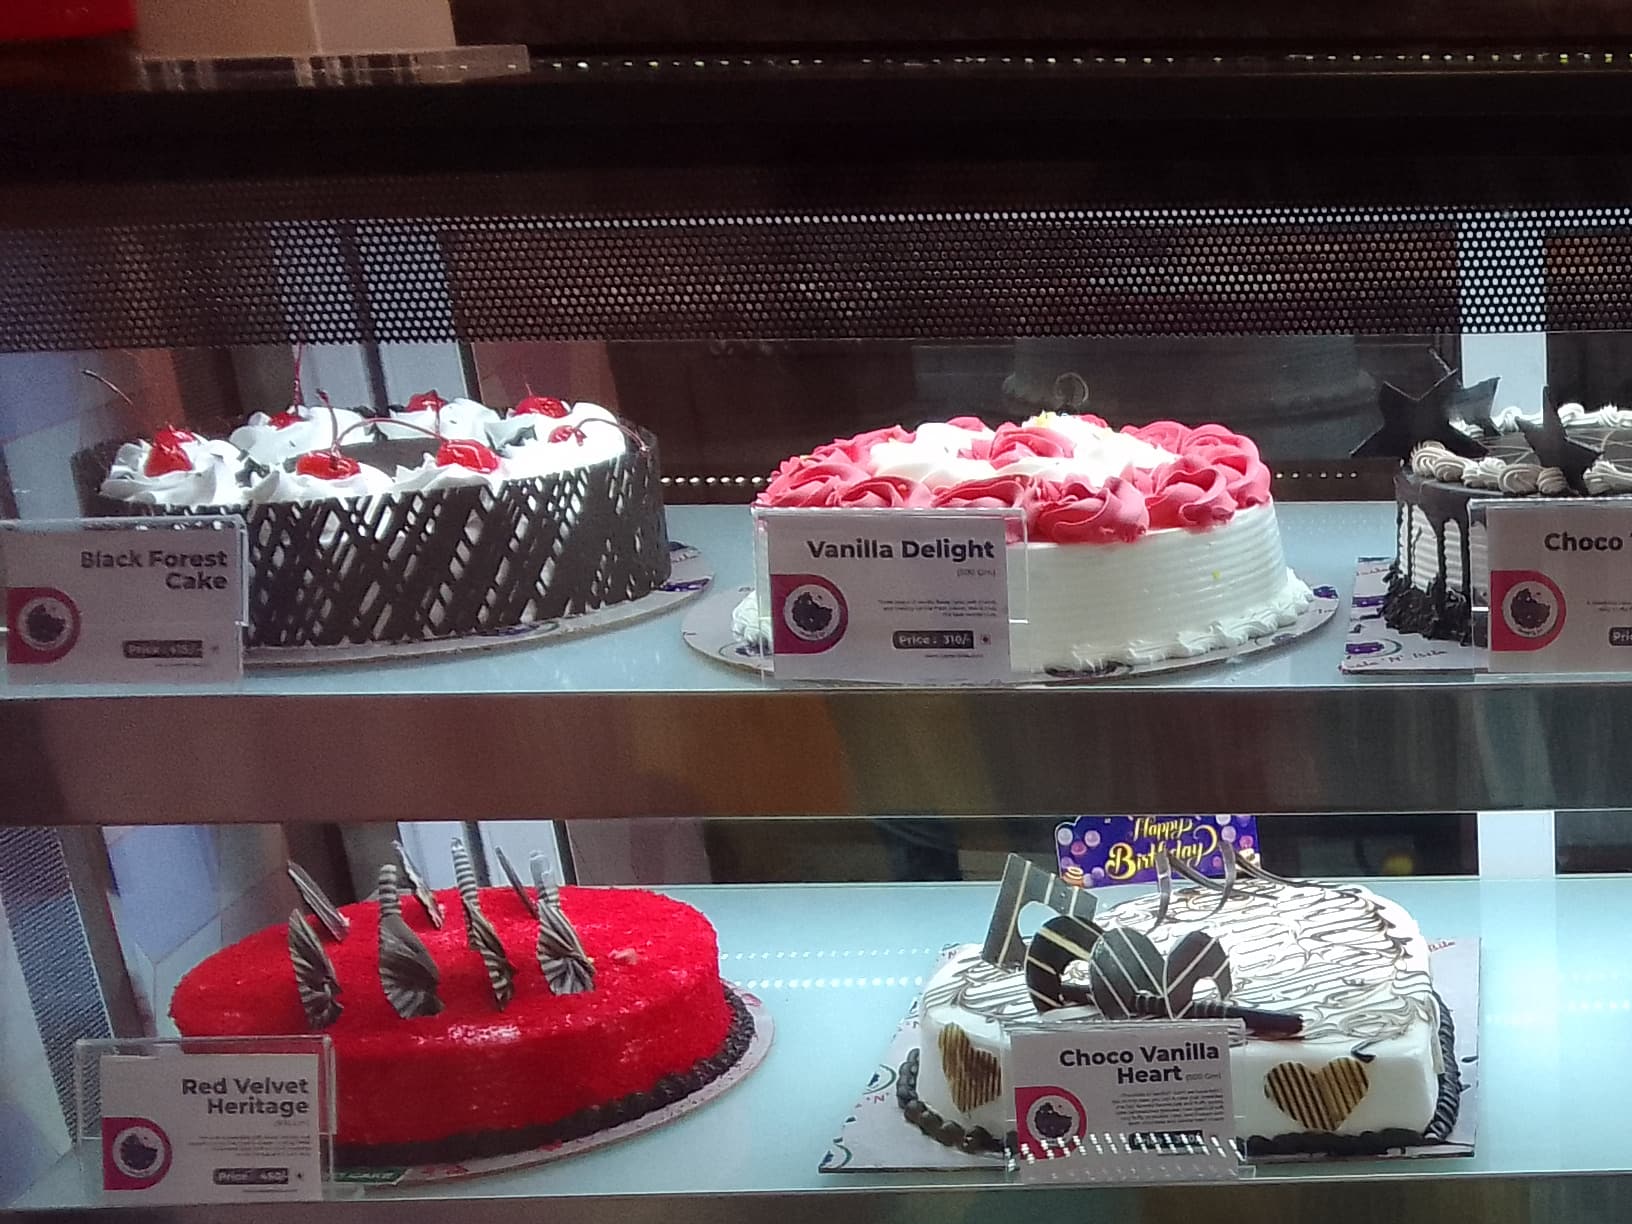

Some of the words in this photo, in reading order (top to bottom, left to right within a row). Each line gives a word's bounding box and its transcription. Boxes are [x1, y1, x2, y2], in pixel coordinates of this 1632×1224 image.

[807, 538, 893, 560] Vanilla
[901, 538, 995, 562] Delight
[1544, 532, 1623, 552] Choco
[80, 550, 143, 569] Black
[149, 550, 228, 569] Forest
[165, 572, 228, 590] Cake
[899, 635, 931, 645] Price
[1133, 816, 1193, 841] Happy
[1060, 1049, 1134, 1067] Choco
[1140, 1041, 1219, 1062] Vanilla
[1117, 1065, 1183, 1085] Heart
[182, 1078, 227, 1095] Red
[234, 1077, 309, 1095] Velvet
[207, 1098, 309, 1117] Heritage
